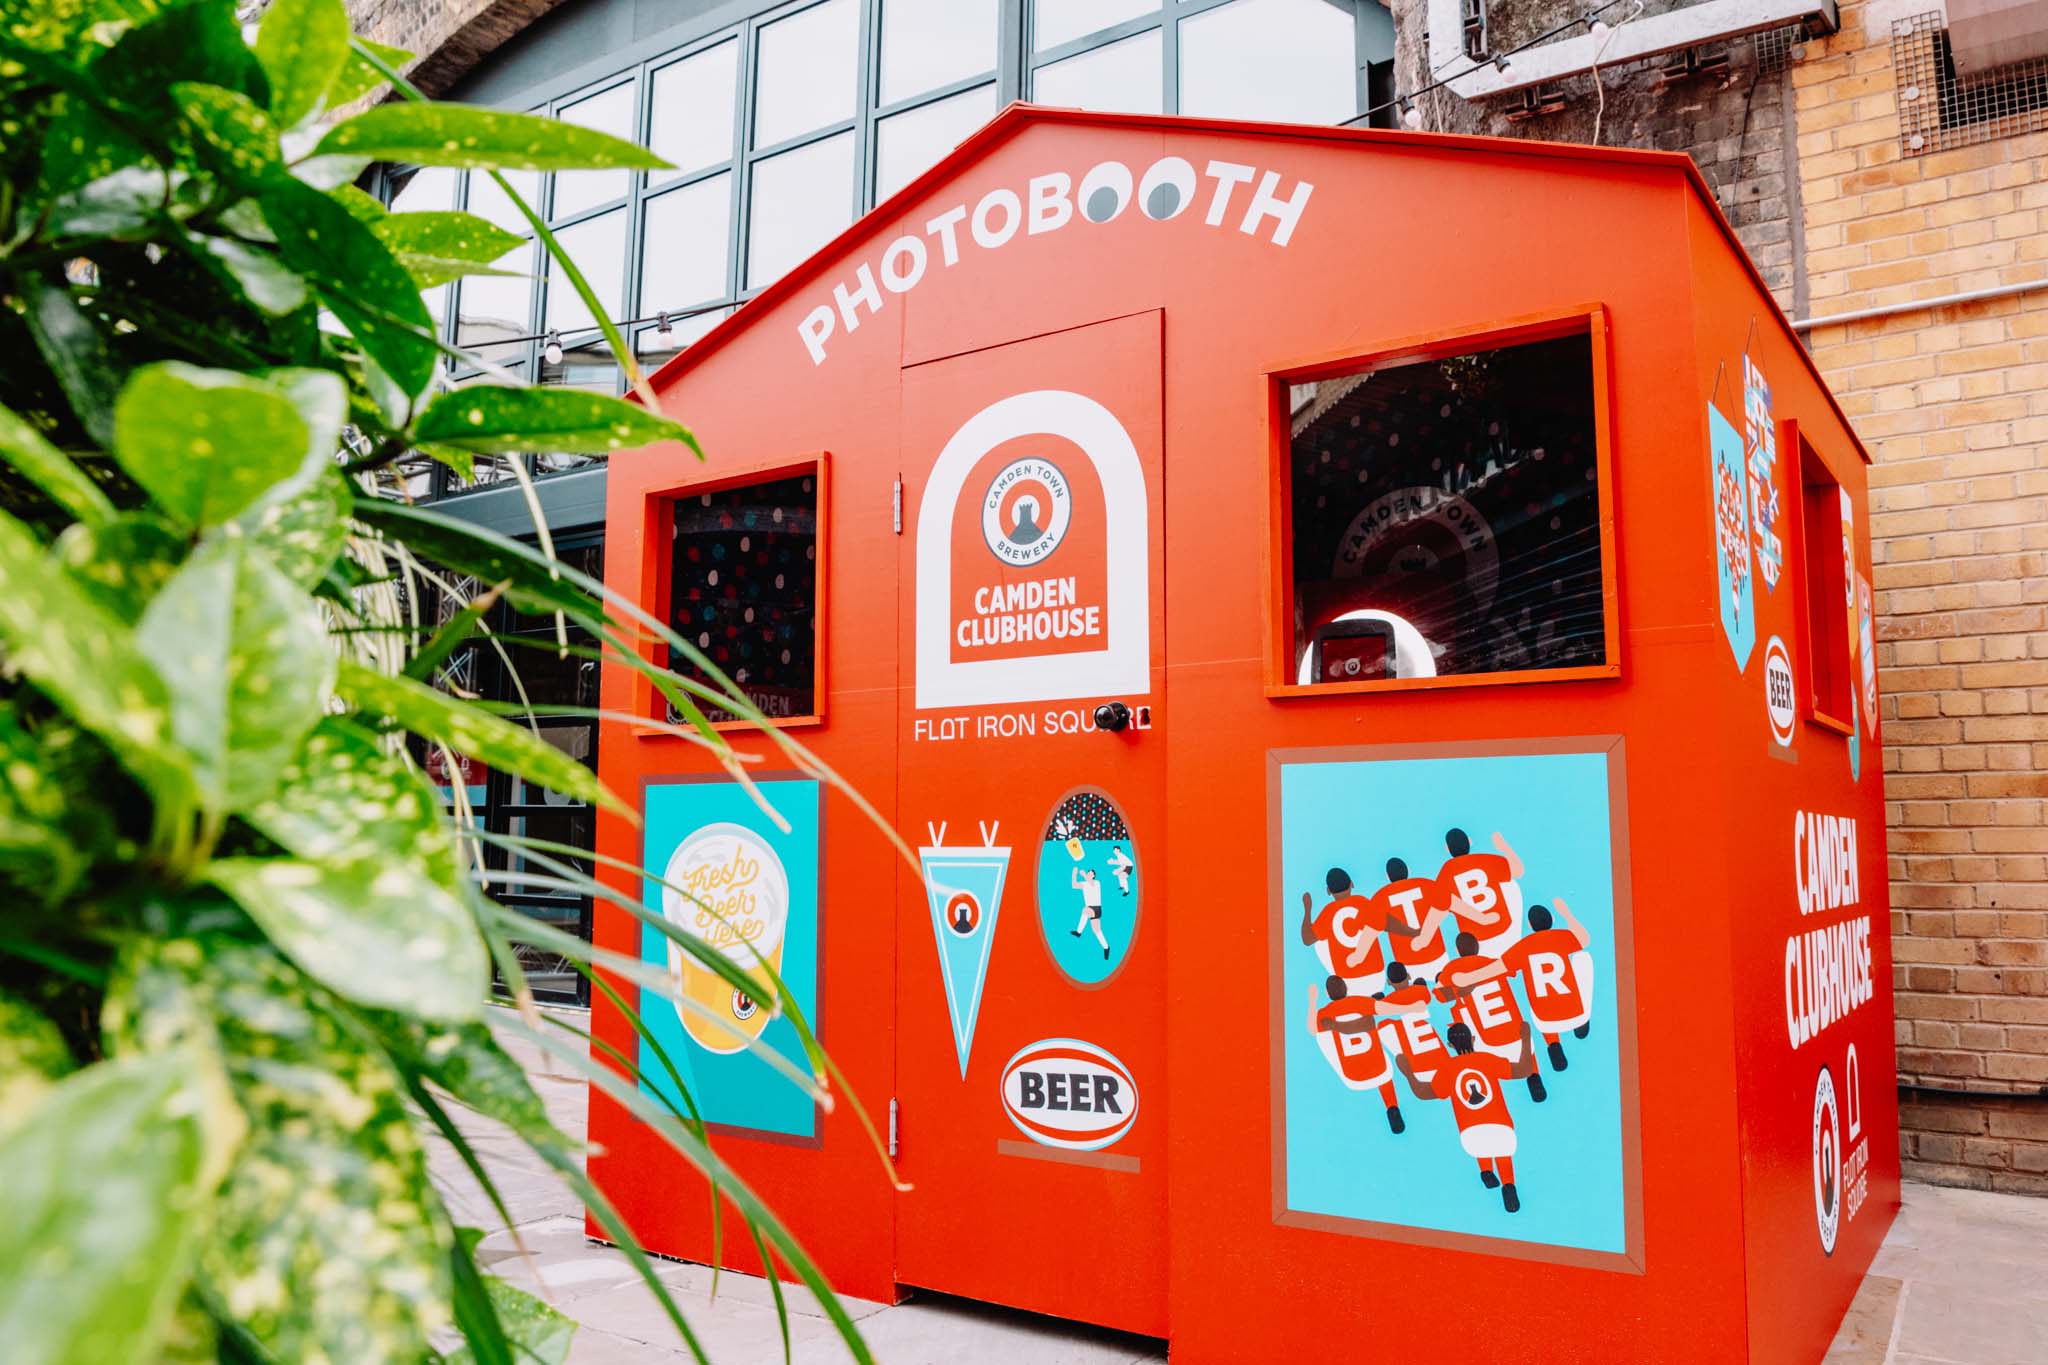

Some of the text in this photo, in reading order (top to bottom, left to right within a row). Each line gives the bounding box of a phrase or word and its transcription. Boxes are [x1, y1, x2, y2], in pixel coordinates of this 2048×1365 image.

[797, 156, 1314, 365] PHOTOBOOTH
[989, 465, 1064, 509] CAMDEN TOWN
[997, 532, 1055, 560] BREWERY
[974, 576, 1076, 615] CAMDEN
[957, 606, 1100, 648] CLUBHOUSE
[1769, 668, 1792, 710] BEER
[977, 713, 1035, 738] IRON
[682, 843, 760, 903] Fresh
[1793, 810, 1859, 916] CAMDEN
[695, 889, 756, 928] Beer
[1784, 916, 1873, 1050] CLUBHOUSE
[1019, 1070, 1123, 1115] BEER
